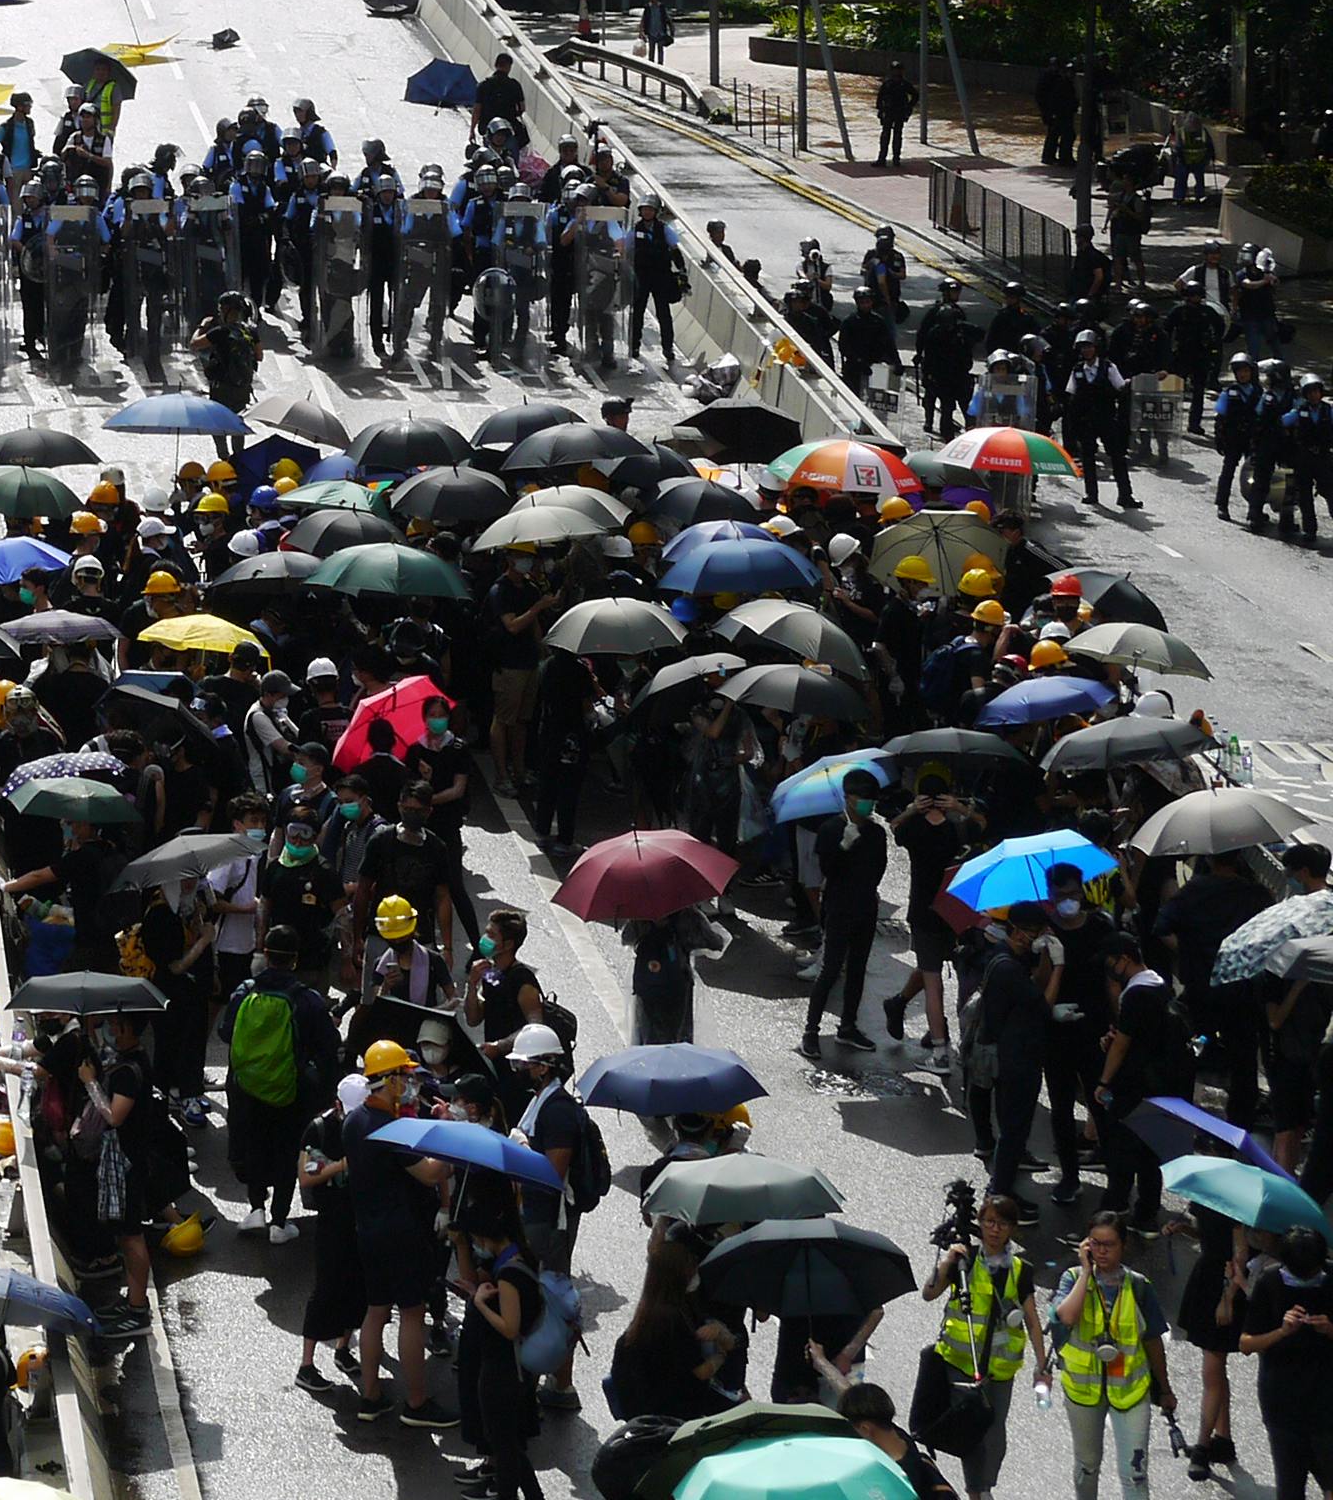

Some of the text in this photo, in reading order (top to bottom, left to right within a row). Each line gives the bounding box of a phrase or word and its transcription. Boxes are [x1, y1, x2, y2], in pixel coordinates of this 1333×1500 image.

[872, 403, 897, 411] POLICE
[1142, 412, 1173, 420] POLICE
[981, 456, 1023, 467] 7-ELEVEN
